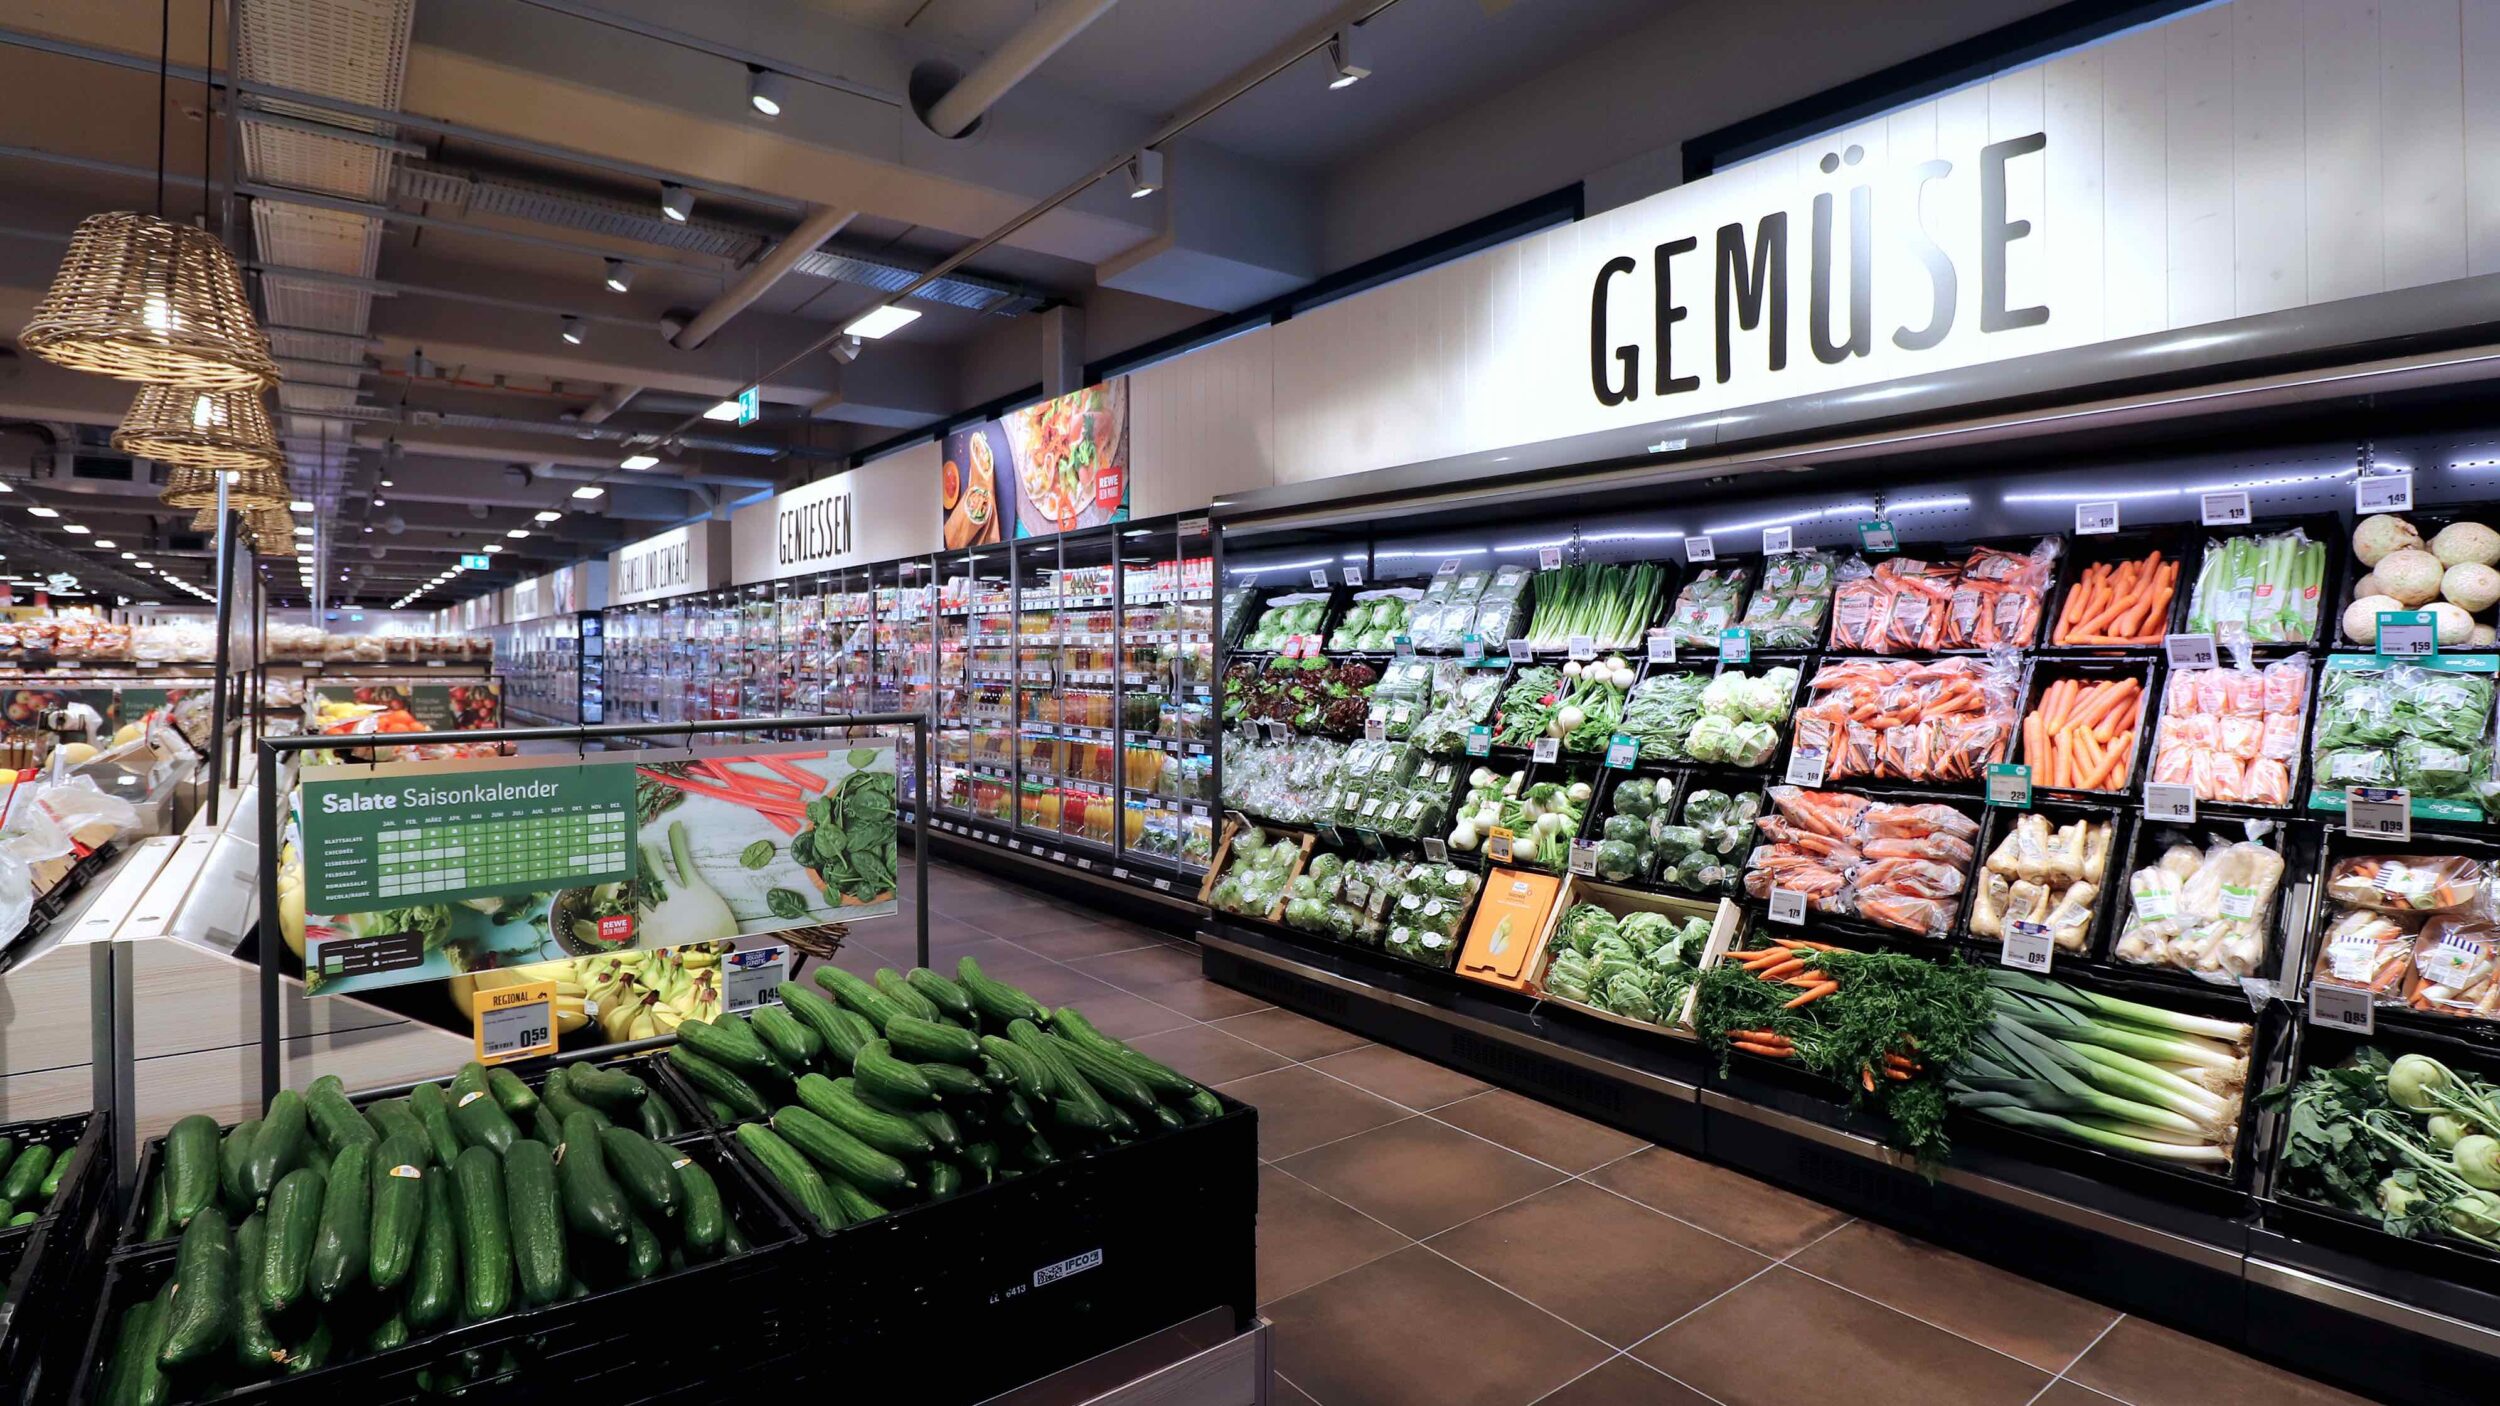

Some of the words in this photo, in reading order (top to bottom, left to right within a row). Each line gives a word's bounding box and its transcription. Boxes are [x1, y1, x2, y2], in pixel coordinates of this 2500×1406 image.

[1591, 131, 2050, 406] GEMÜSE
[1099, 474, 1119, 488] REWE
[779, 492, 851, 565] GENIESSEN
[660, 539, 690, 588] EINFACH
[322, 791, 398, 814] Salate
[403, 780, 559, 808] Saisonkalender
[603, 919, 628, 929] REWE
[493, 991, 529, 1007] REGIONAL
[1065, 1254, 1090, 1271] IFCO
